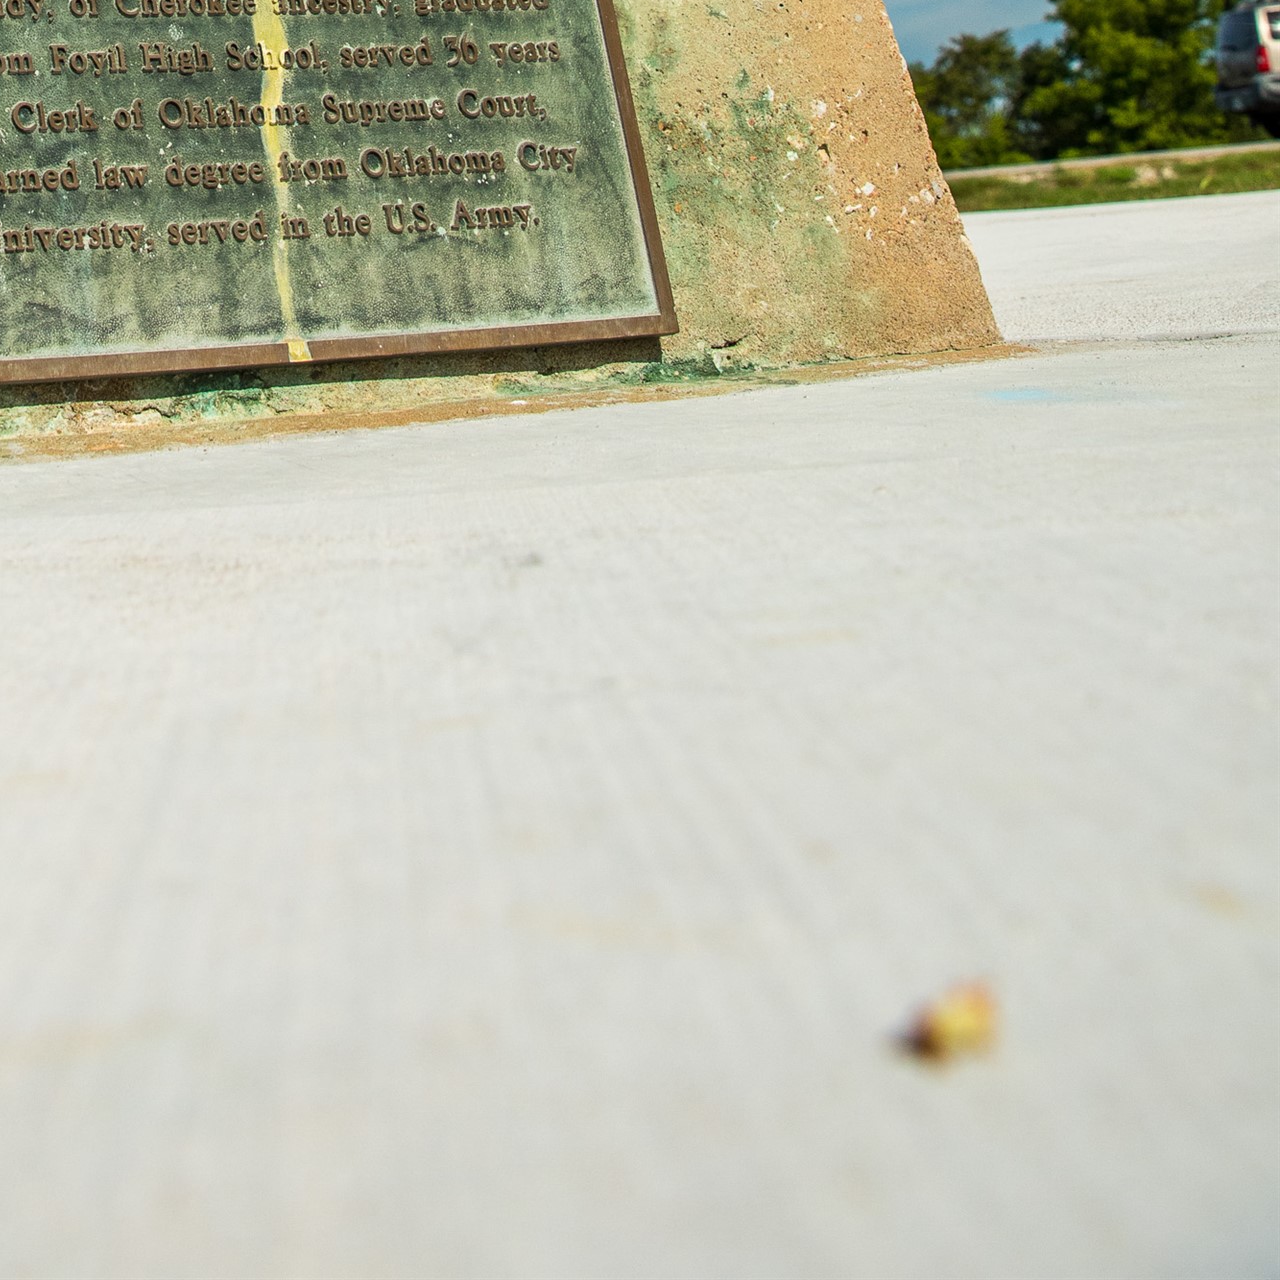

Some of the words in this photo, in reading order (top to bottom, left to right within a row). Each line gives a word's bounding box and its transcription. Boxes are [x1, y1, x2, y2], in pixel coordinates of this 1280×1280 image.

[49, 44, 127, 77] Foyil
[140, 42, 214, 75] High
[226, 42, 329, 73] School,
[340, 37, 433, 67] served
[443, 33, 478, 67] 36
[490, 40, 561, 66] years
[11, 100, 97, 132] Clerk
[114, 99, 144, 130] of
[159, 97, 310, 126] Oklahoma
[322, 94, 445, 126] Supreme
[458, 88, 546, 120] Court,
[95, 158, 148, 189] law
[166, 156, 265, 187] degree
[279, 152, 348, 182] from
[361, 145, 505, 178] Oklahoma
[517, 141, 577, 173] City
[167, 211, 268, 244] served
[281, 211, 310, 240] in
[324, 206, 370, 236] the
[383, 203, 436, 233] U.S.
[451, 199, 540, 231] Army.
